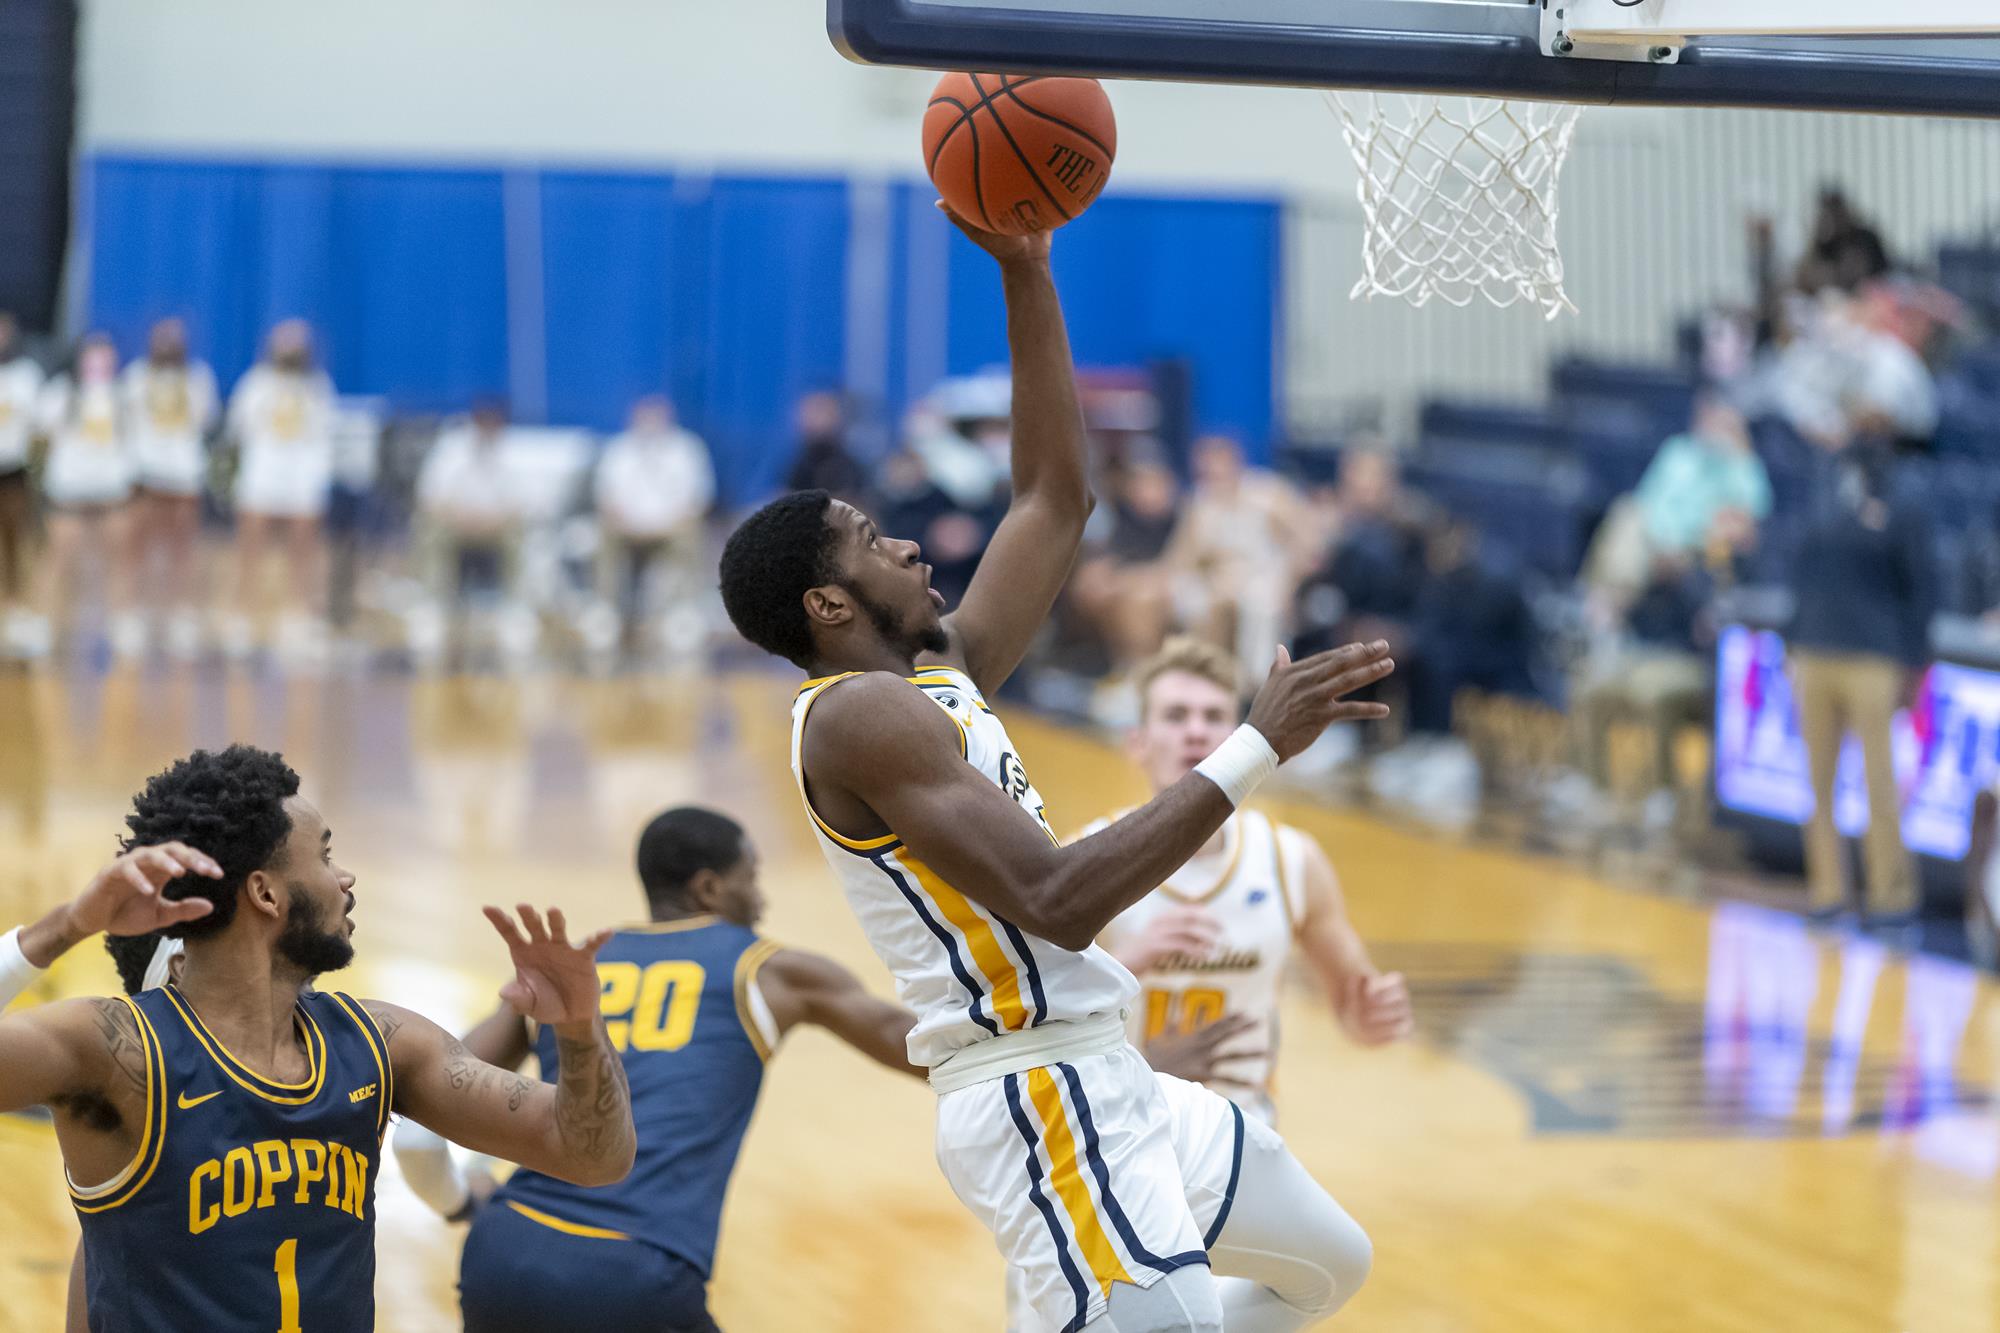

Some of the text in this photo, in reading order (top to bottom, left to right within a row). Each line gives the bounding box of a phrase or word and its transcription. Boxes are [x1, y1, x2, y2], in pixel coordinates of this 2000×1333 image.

[1046, 144, 1096, 193] THE
[595, 960, 706, 1053] 20
[188, 1138, 369, 1235] COPPIN
[274, 1238, 302, 1333] 1
